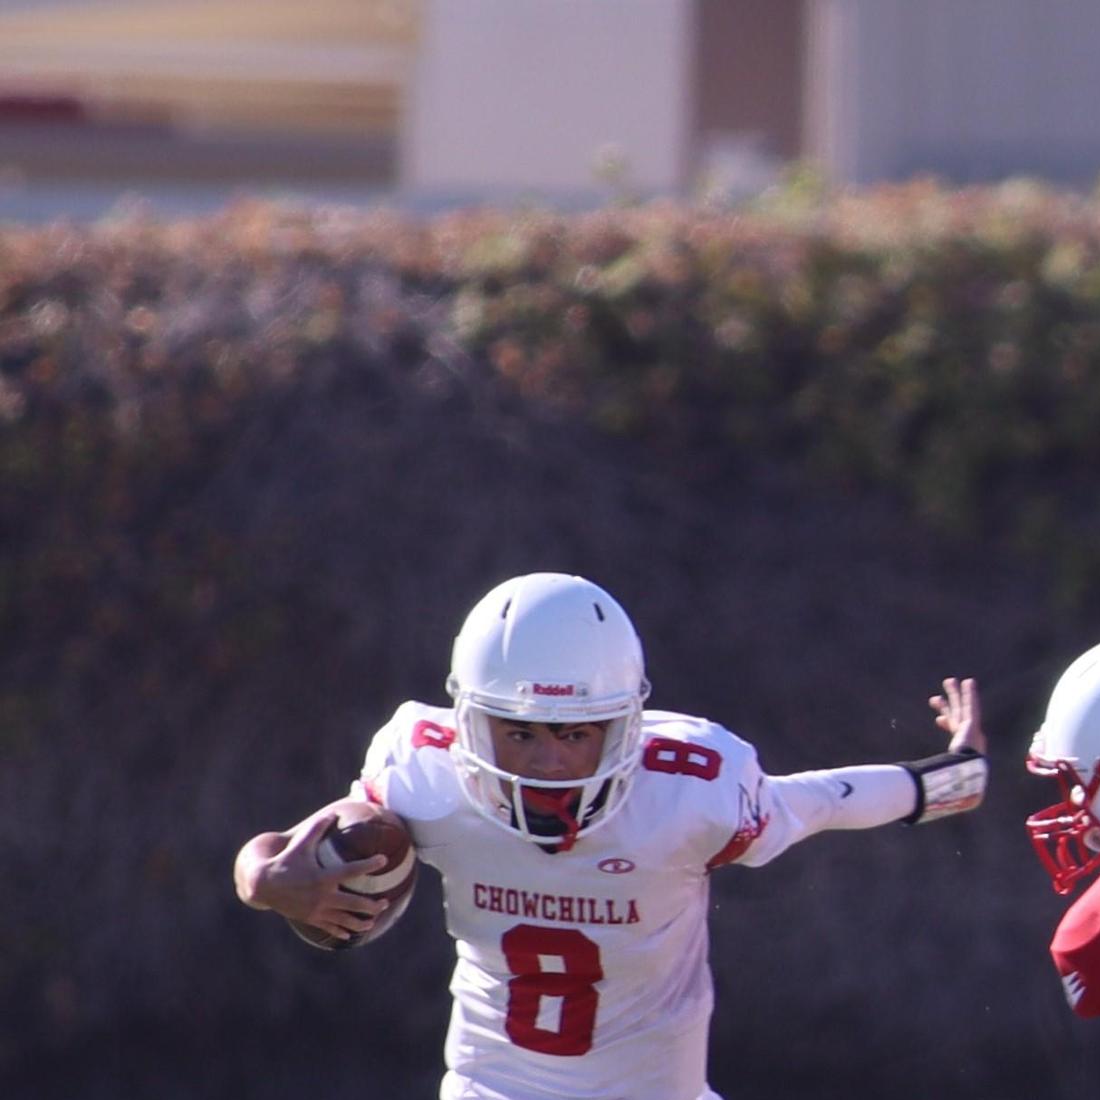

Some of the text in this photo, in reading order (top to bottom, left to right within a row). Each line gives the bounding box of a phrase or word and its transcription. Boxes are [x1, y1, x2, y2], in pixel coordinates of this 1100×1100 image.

[532, 683, 574, 697] Riddell
[642, 738, 723, 781] 8
[473, 882, 641, 925] CHOWCHILLA
[501, 923, 604, 1056] 8
